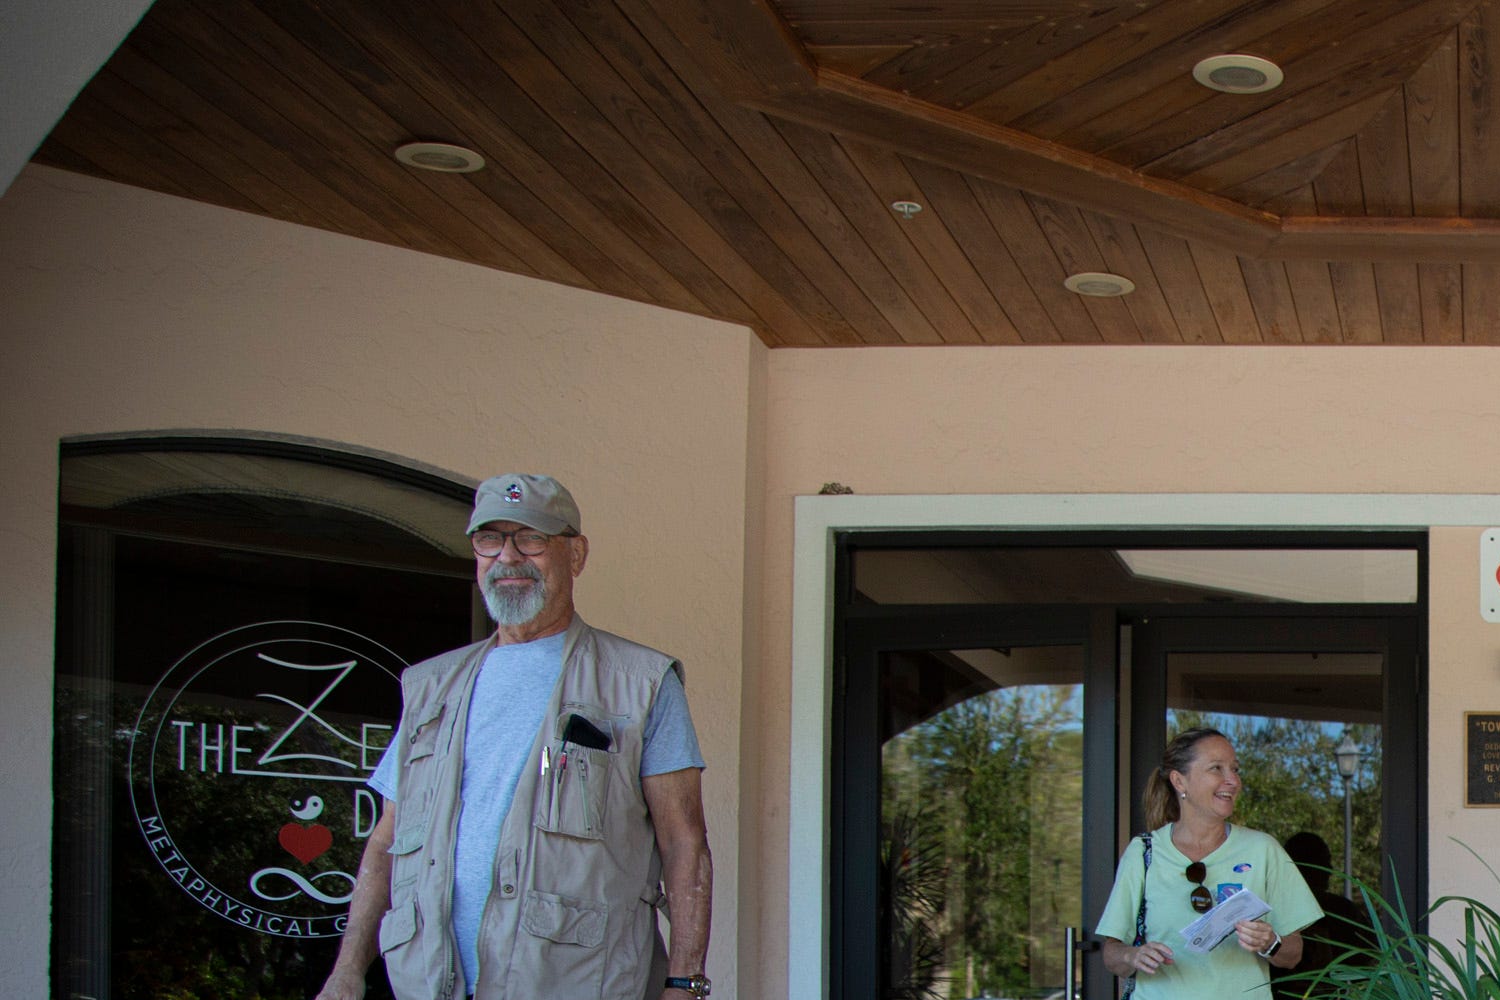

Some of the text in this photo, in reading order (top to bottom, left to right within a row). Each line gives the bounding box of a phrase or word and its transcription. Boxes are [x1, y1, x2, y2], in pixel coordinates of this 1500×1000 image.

[171, 652, 393, 773] THE ZE
[141, 816, 320, 936] METAPHYSICAL
